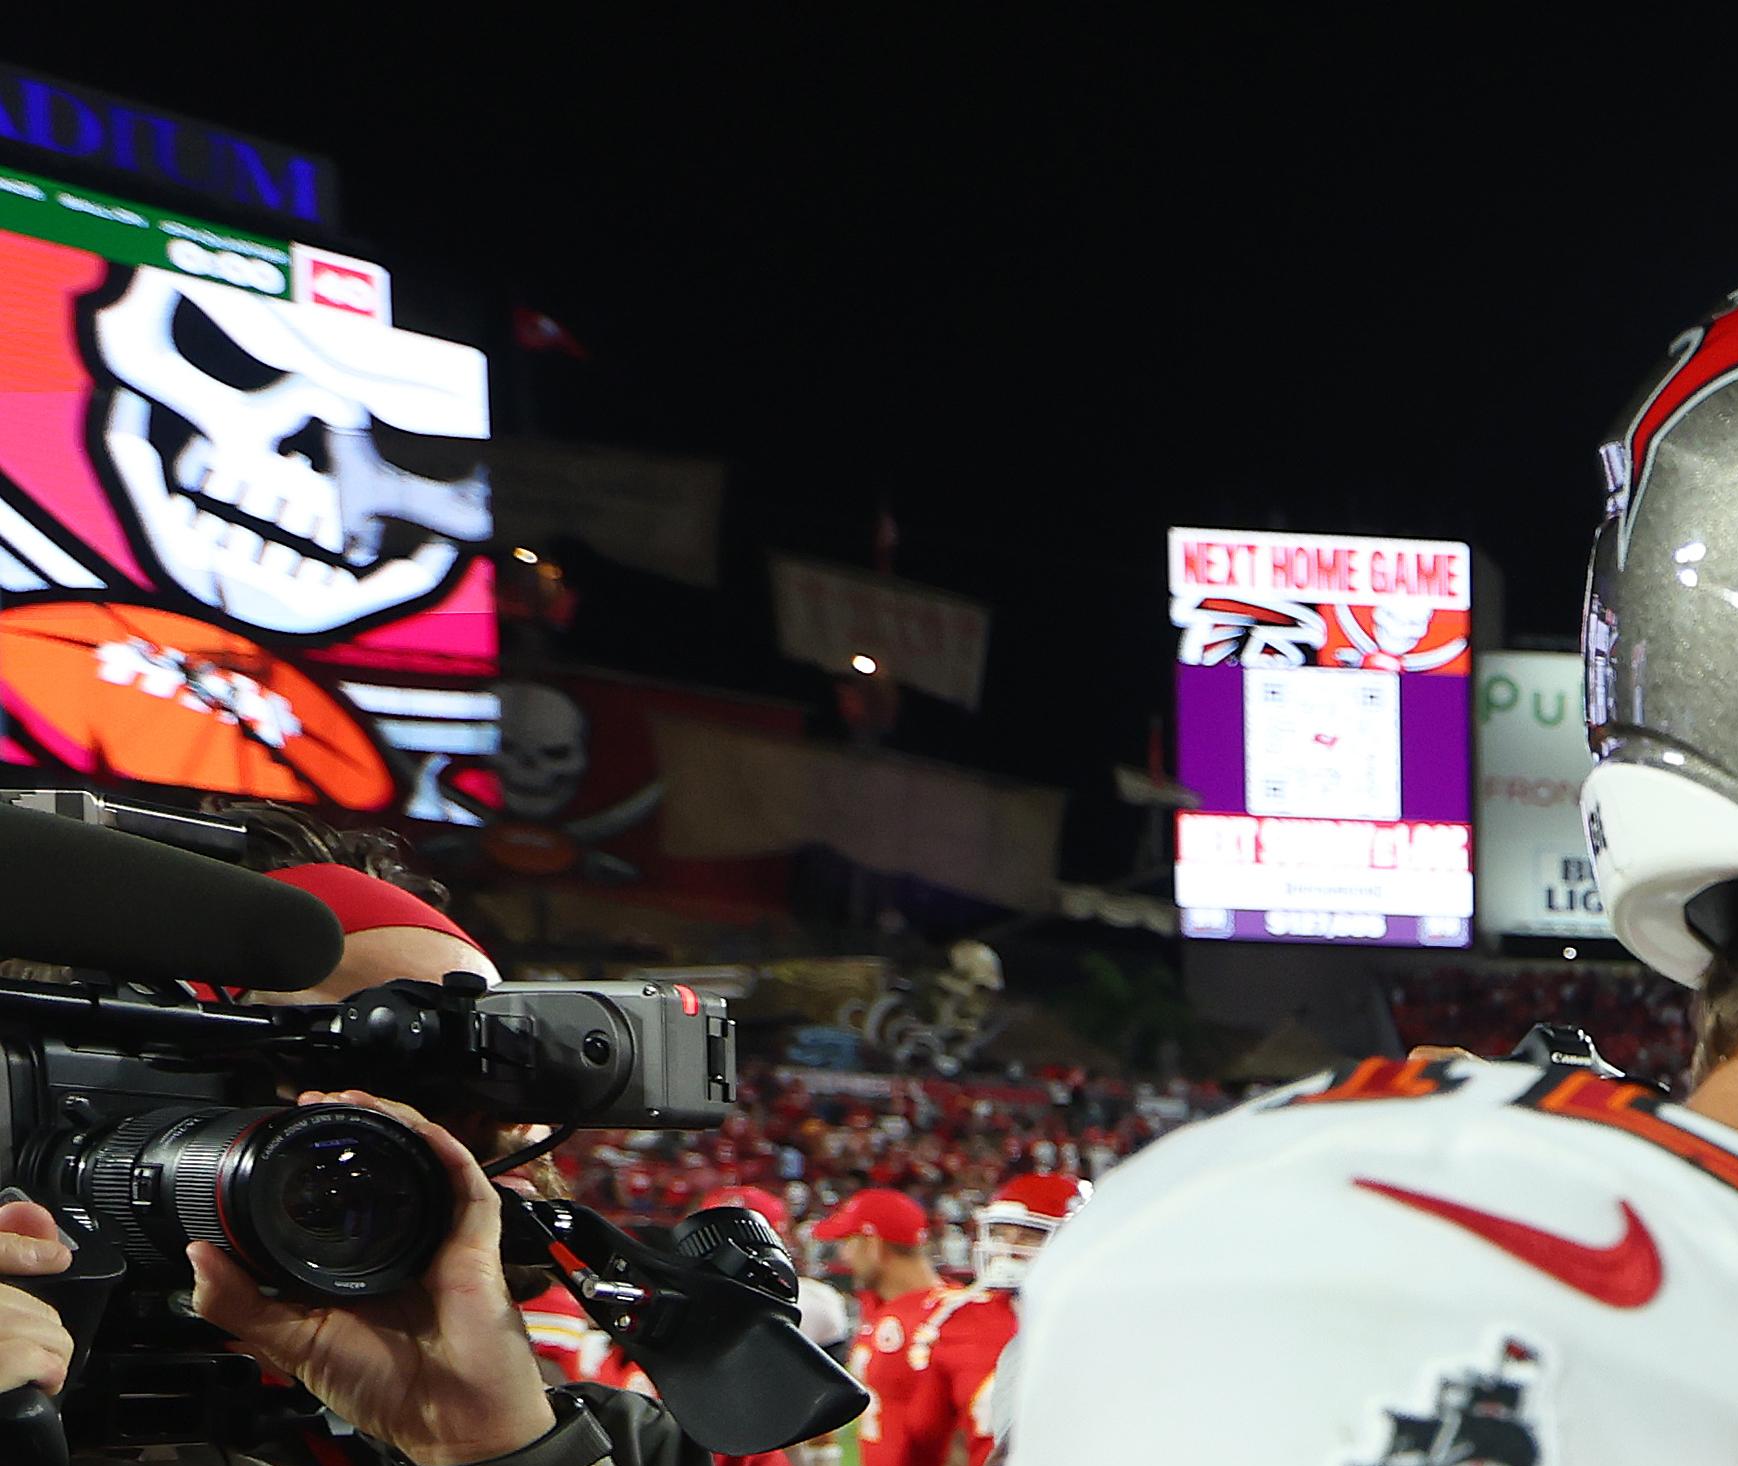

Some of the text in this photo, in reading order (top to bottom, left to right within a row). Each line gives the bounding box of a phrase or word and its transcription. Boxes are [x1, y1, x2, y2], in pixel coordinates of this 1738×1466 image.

[1183, 541, 1459, 597] NEXT HOME GAME
